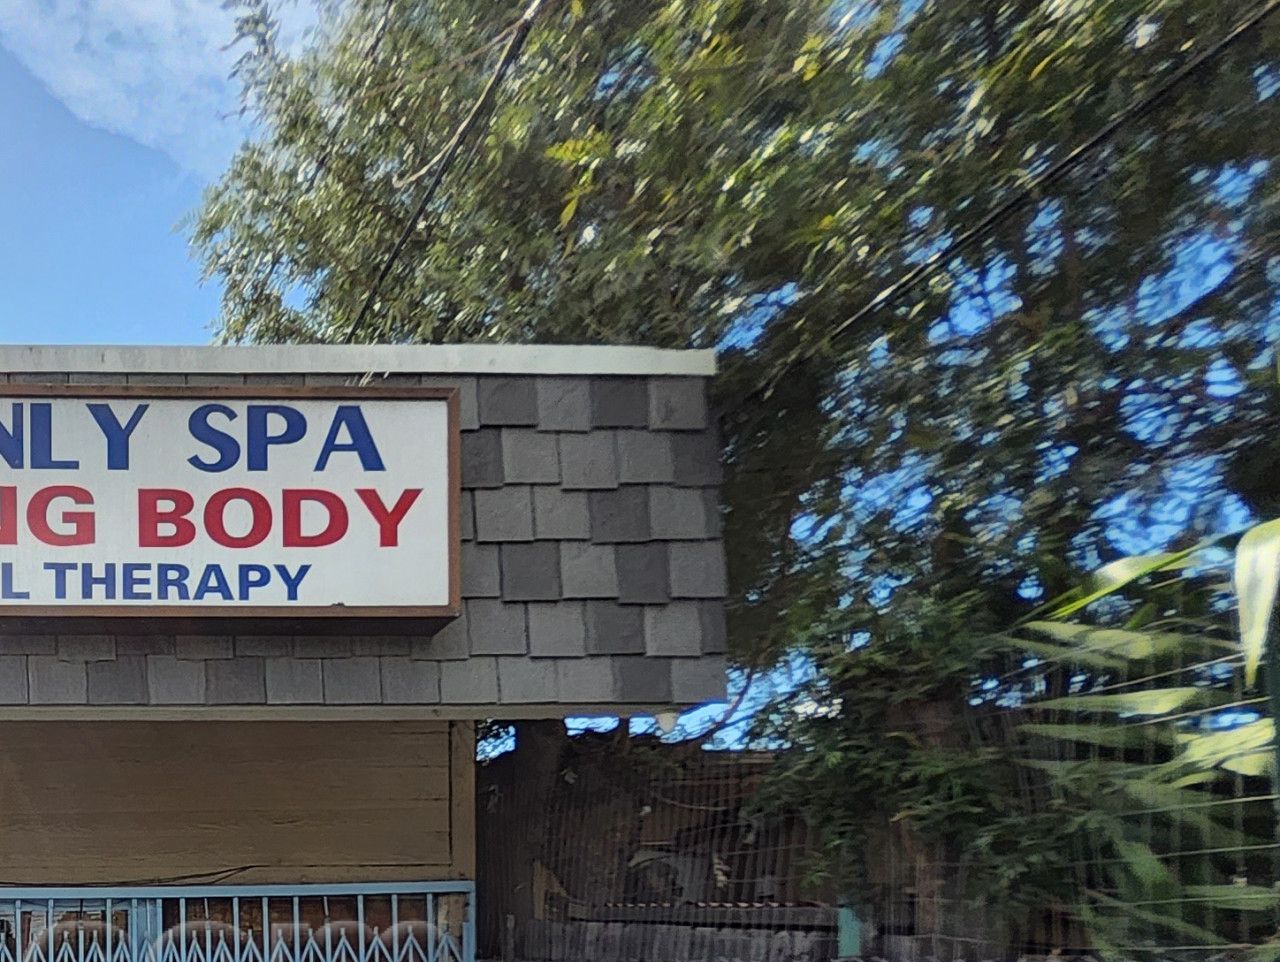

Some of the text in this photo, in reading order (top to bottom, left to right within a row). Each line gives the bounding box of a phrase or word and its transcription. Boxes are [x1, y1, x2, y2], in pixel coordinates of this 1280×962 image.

[185, 402, 388, 473] SPA
[138, 487, 423, 549] BODY
[53, 562, 312, 603] THERAPY
